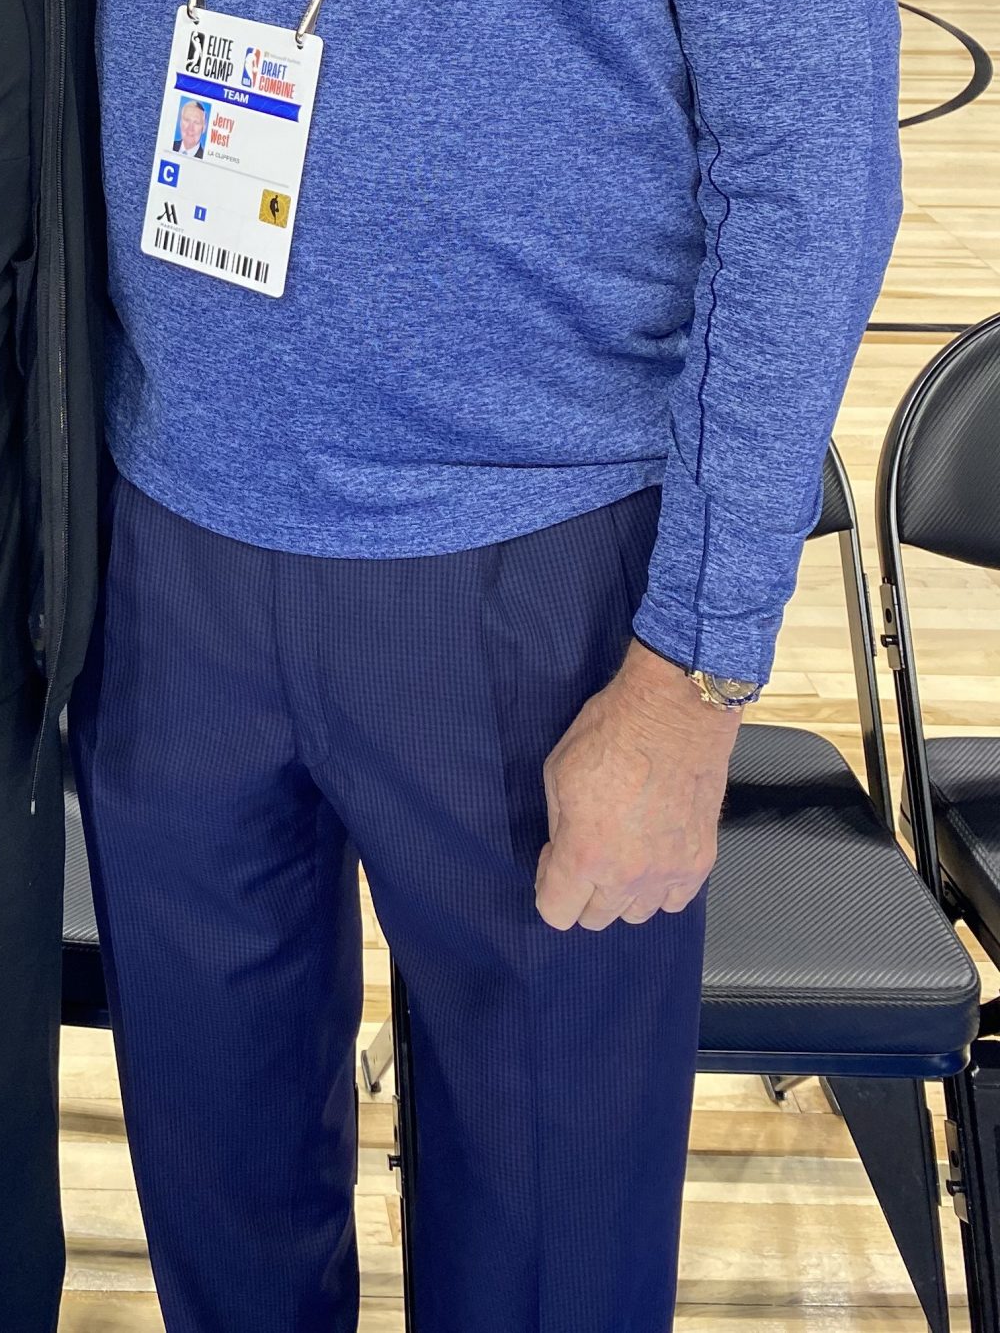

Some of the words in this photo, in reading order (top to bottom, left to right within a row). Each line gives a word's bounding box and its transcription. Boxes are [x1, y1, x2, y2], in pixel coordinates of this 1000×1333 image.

[207, 35, 234, 60] ELITE
[203, 57, 234, 82] CAMP
[261, 60, 287, 80] DRAFT
[223, 88, 249, 104] TEAM
[259, 76, 295, 99] COMBINE
[212, 112, 235, 133] Jerry
[210, 128, 230, 148] West
[163, 166, 174, 182] C
